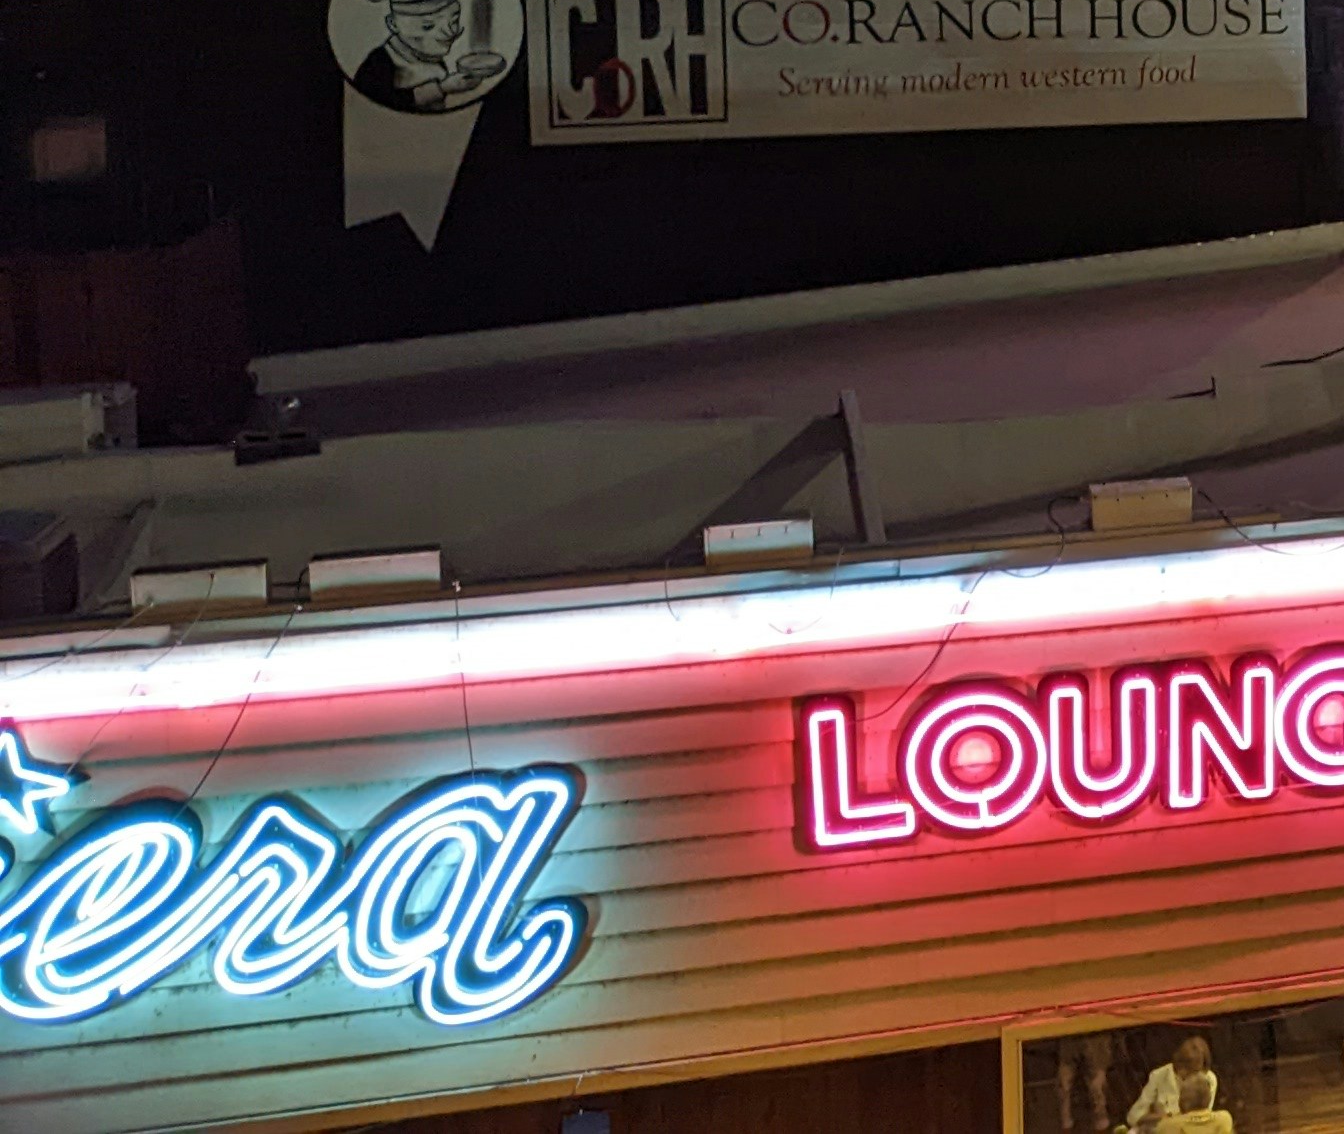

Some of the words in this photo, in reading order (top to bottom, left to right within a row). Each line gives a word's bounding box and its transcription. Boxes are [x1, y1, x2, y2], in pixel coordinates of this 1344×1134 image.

[778, 67, 888, 98] Serving
[900, 63, 1010, 93] modern
[1020, 64, 1126, 88] western
[1136, 54, 1197, 89] food
